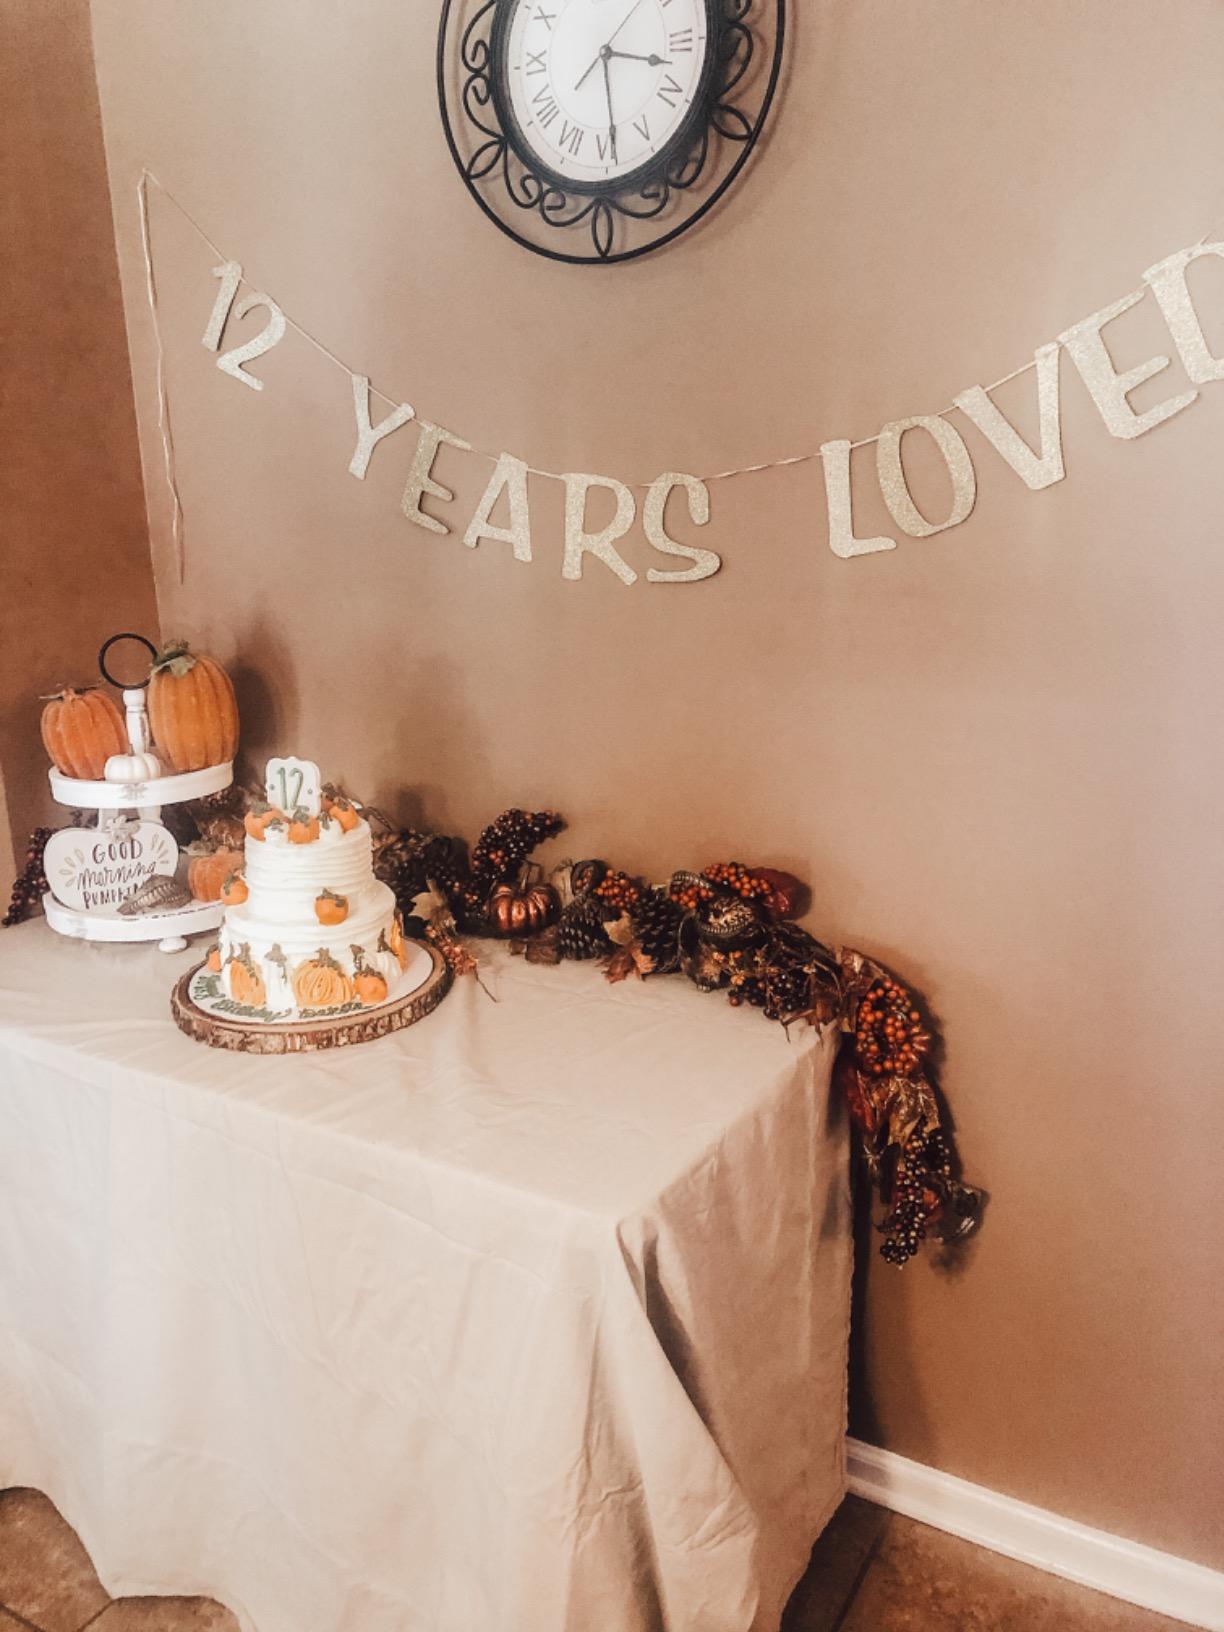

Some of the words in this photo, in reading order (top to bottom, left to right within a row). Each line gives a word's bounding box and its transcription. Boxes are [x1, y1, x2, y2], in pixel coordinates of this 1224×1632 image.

[534, 5, 557, 31] X
[669, 28, 693, 53] III
[526, 49, 547, 76] IX
[531, 83, 560, 129] VIII
[656, 74, 684, 108] IV
[558, 119, 584, 157] VII
[632, 113, 650, 141] V
[202, 260, 286, 391] 12
[348, 373, 722, 587] YEARS
[820, 241, 1224, 559] LOVED
[276, 766, 310, 812] 12
[92, 838, 144, 864] GOOD
